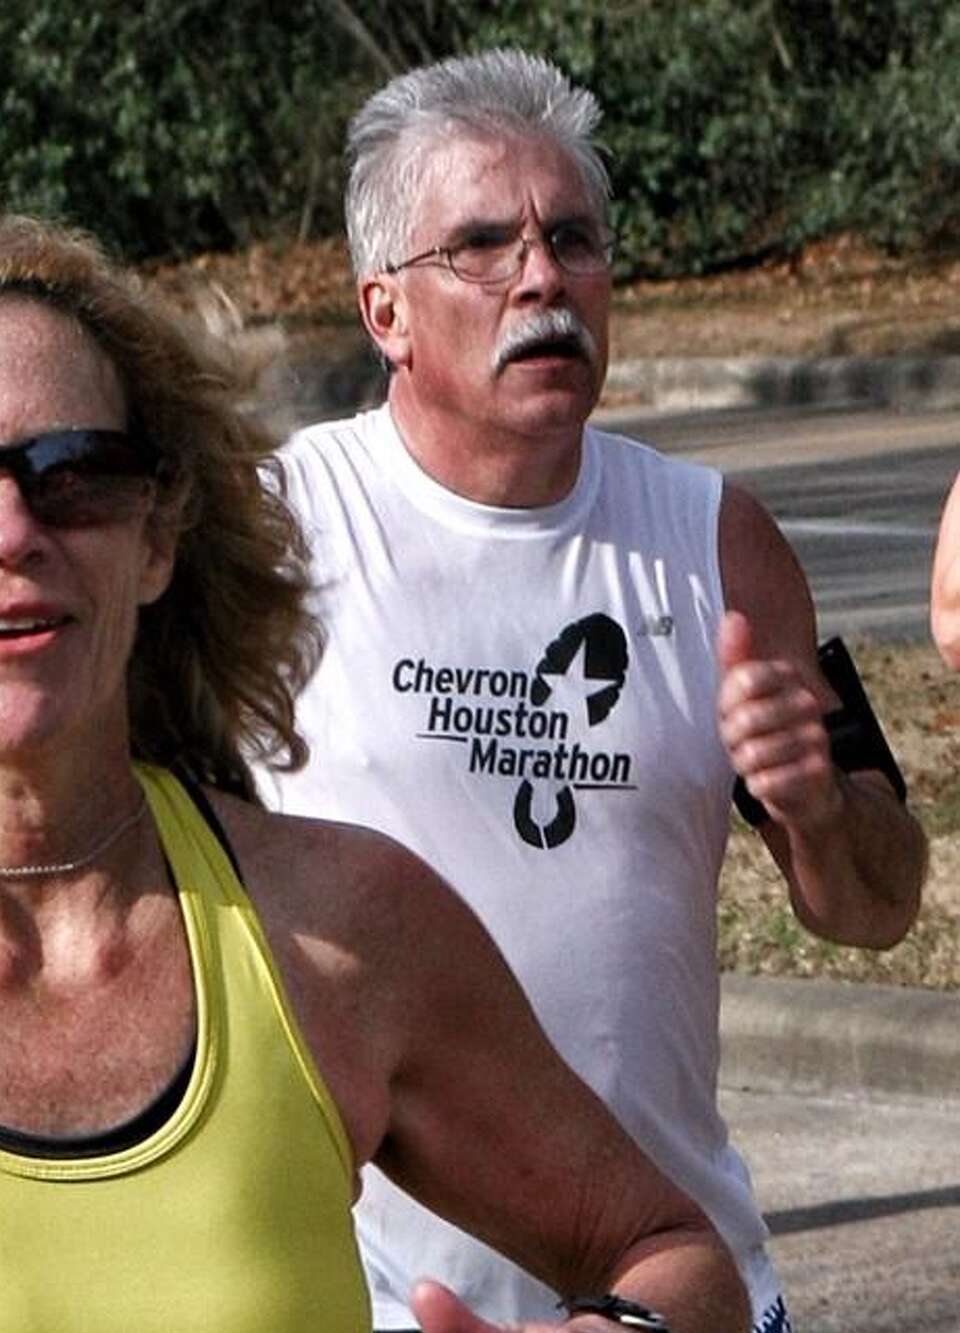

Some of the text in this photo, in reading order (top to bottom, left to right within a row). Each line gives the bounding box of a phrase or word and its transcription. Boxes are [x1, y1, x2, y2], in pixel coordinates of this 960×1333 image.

[393, 658, 527, 698] Chevron
[428, 698, 568, 740] Houston
[469, 738, 631, 782] Marathon
